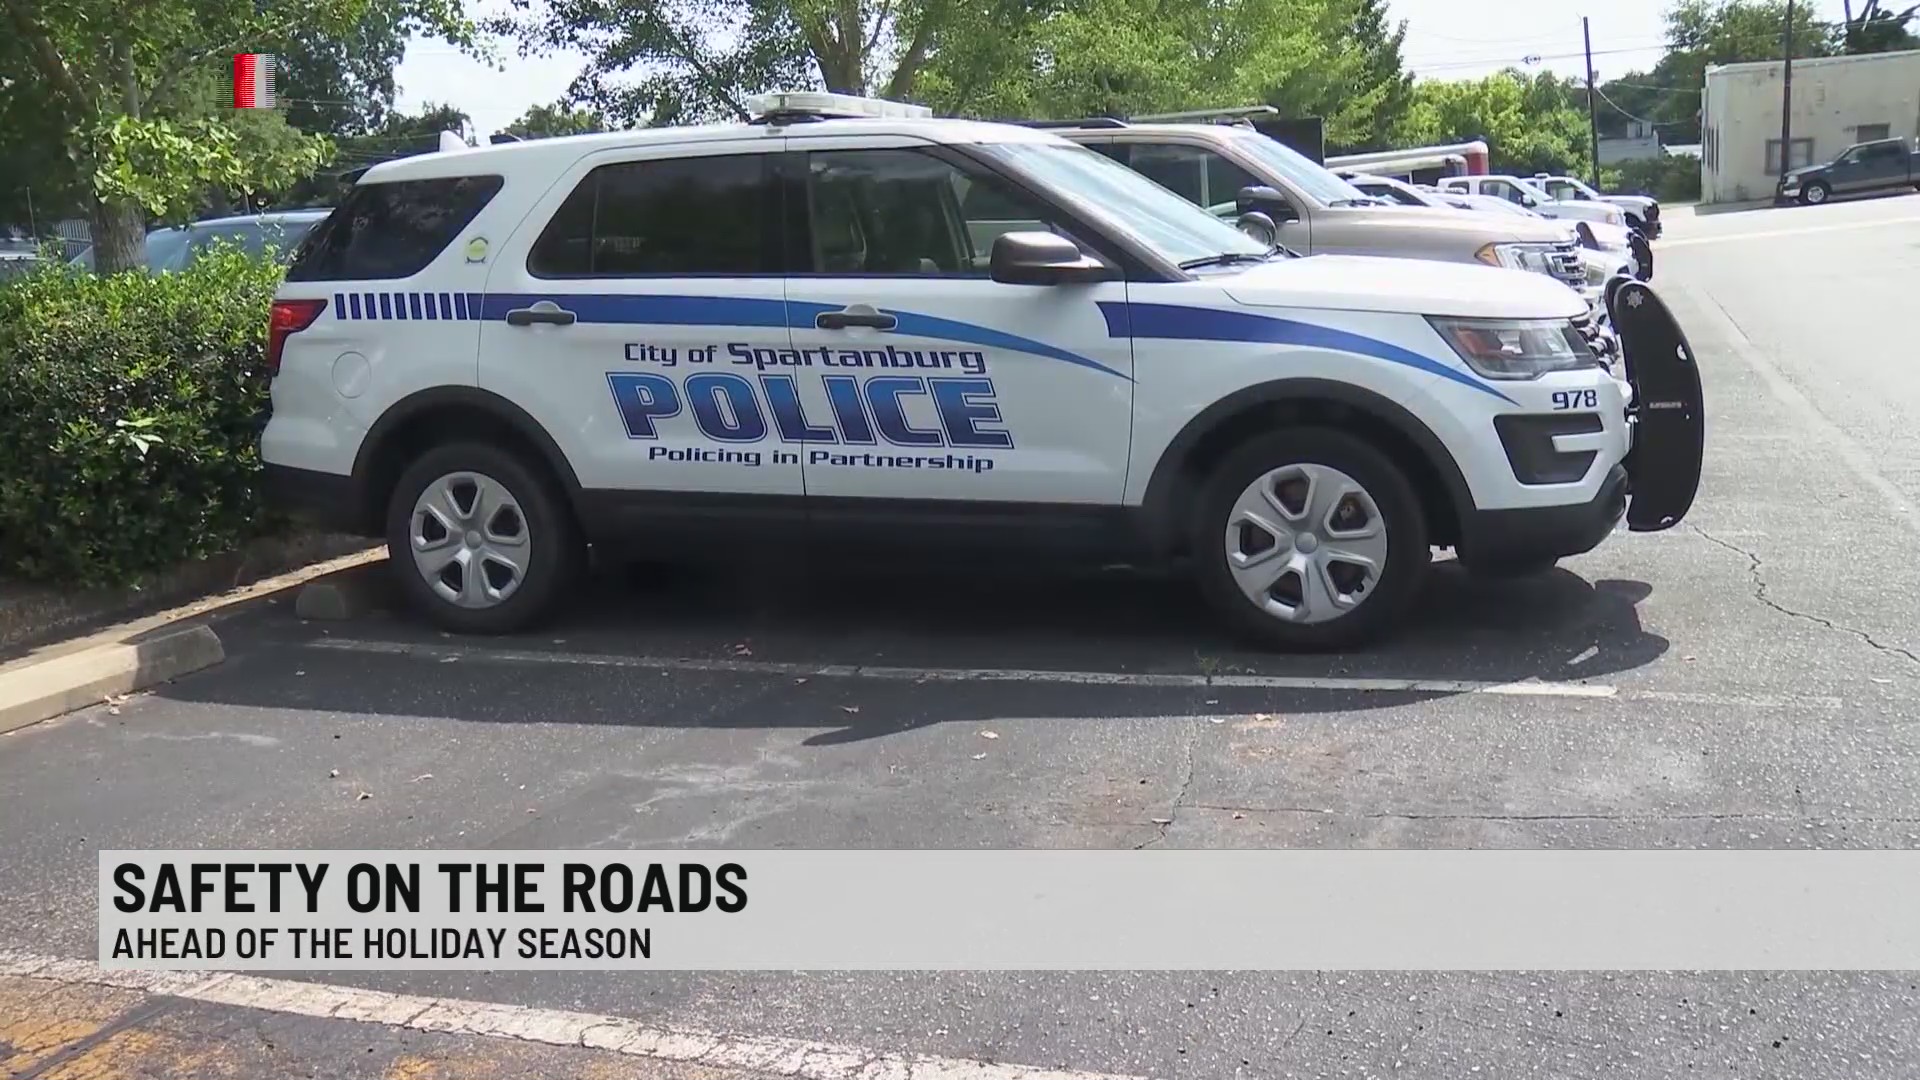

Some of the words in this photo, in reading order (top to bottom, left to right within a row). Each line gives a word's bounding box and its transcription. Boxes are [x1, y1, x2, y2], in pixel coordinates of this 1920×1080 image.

[624, 342, 678, 367] City
[687, 345, 718, 363] of
[727, 343, 986, 375] Spartanburg
[605, 371, 1014, 449] POLICE
[1552, 389, 1597, 410] 978
[648, 446, 761, 467] Policing
[773, 449, 799, 465] in
[809, 450, 993, 473] Partnership
